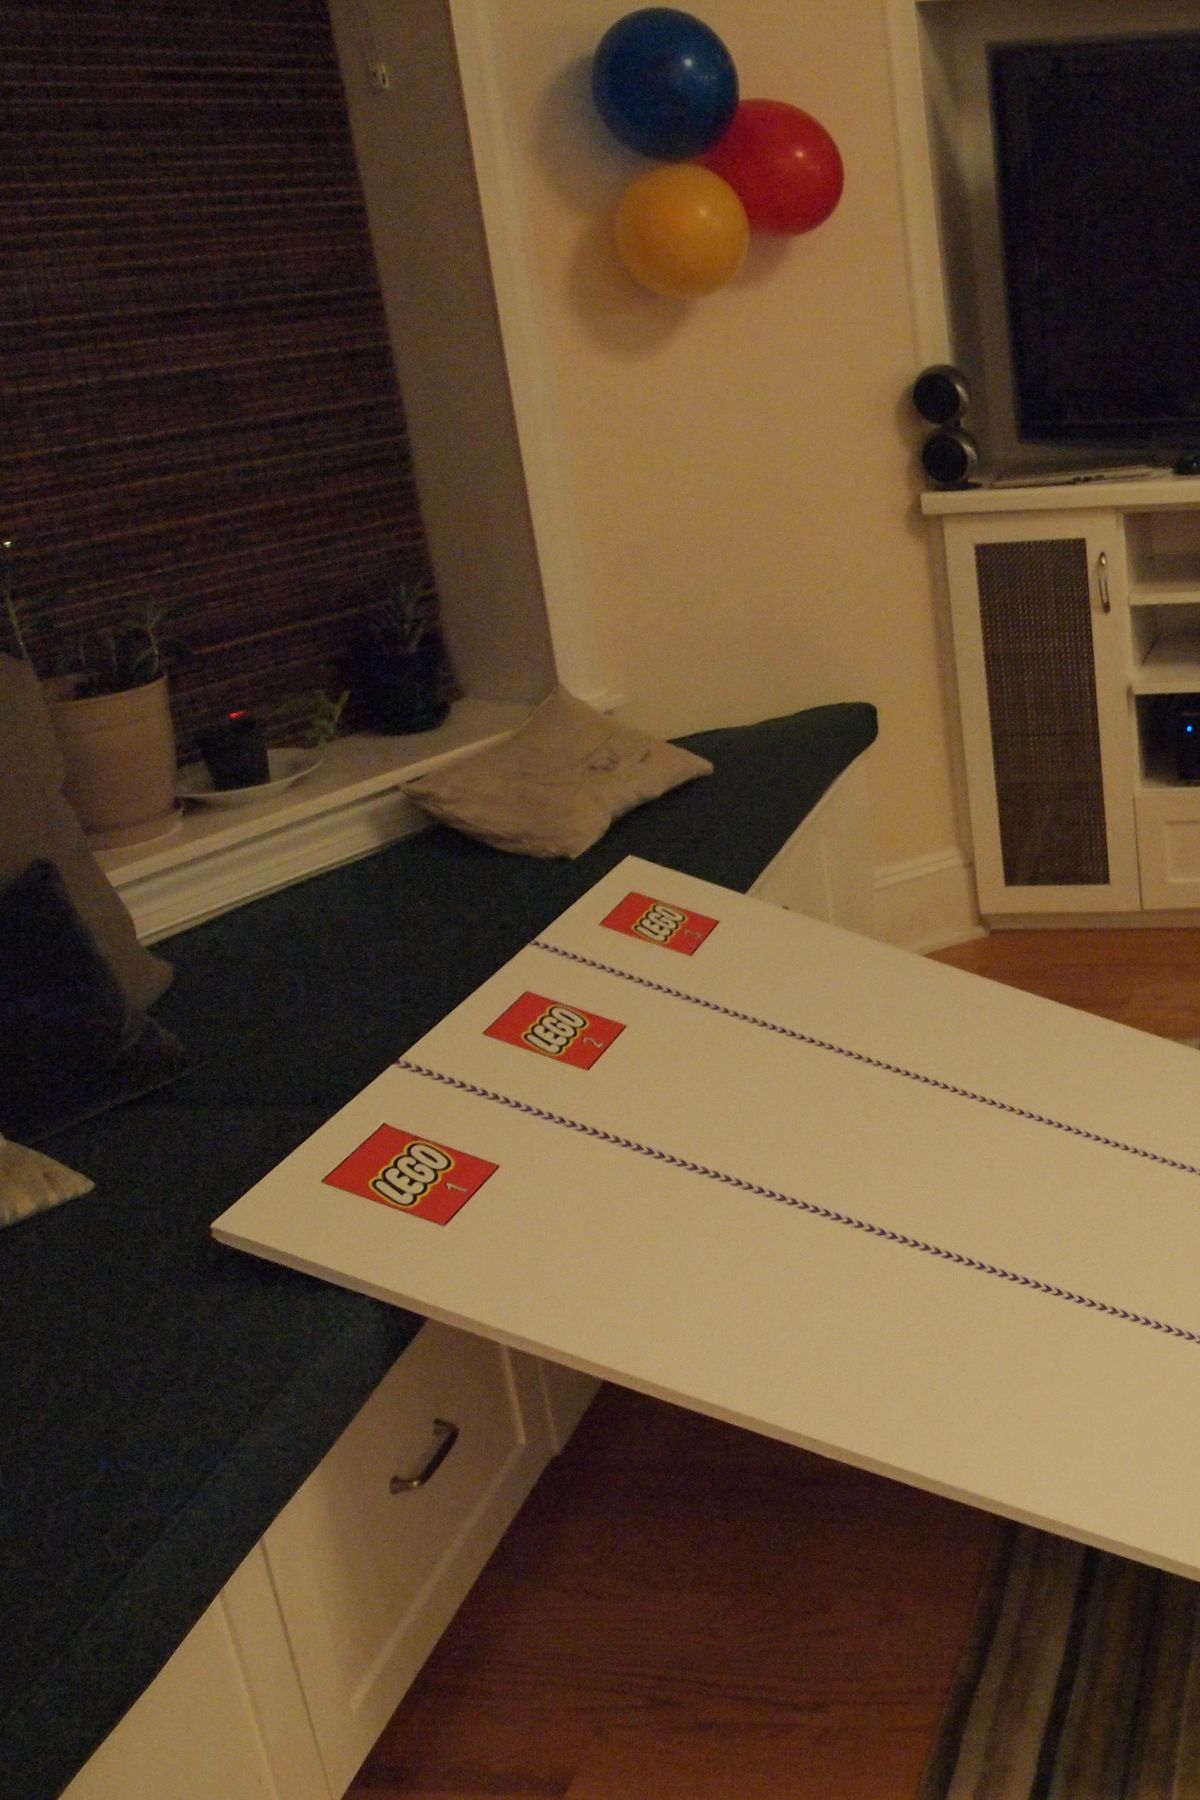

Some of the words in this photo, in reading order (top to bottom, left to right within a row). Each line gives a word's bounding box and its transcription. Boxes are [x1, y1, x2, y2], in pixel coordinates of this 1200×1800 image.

[634, 903, 686, 943] LEGO
[523, 1005, 587, 1056] LEGO
[371, 1142, 452, 1206] LEGO
